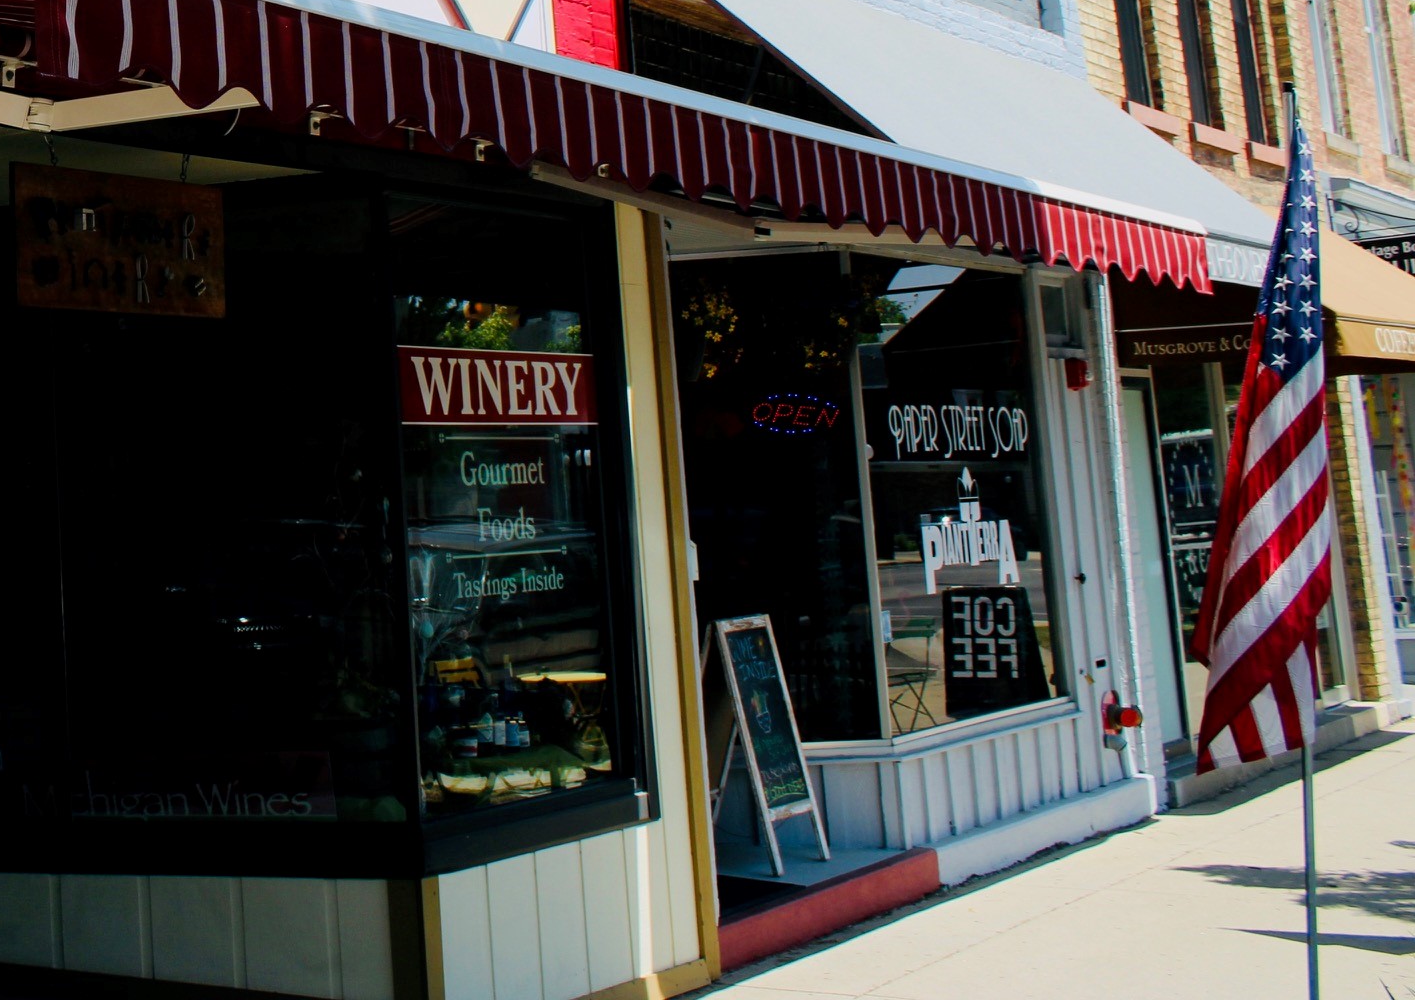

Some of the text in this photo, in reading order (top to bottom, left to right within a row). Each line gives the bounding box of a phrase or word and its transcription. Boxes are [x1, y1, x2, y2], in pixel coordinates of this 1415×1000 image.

[1219, 337, 1231, 352] &
[410, 356, 582, 416] WINERY
[752, 402, 840, 428] OPEN
[888, 404, 1028, 461] PAPER STREET SOAP
[460, 450, 546, 487] Gourmet
[477, 505, 536, 542] Foods
[452, 565, 565, 601] Tastings Inside
